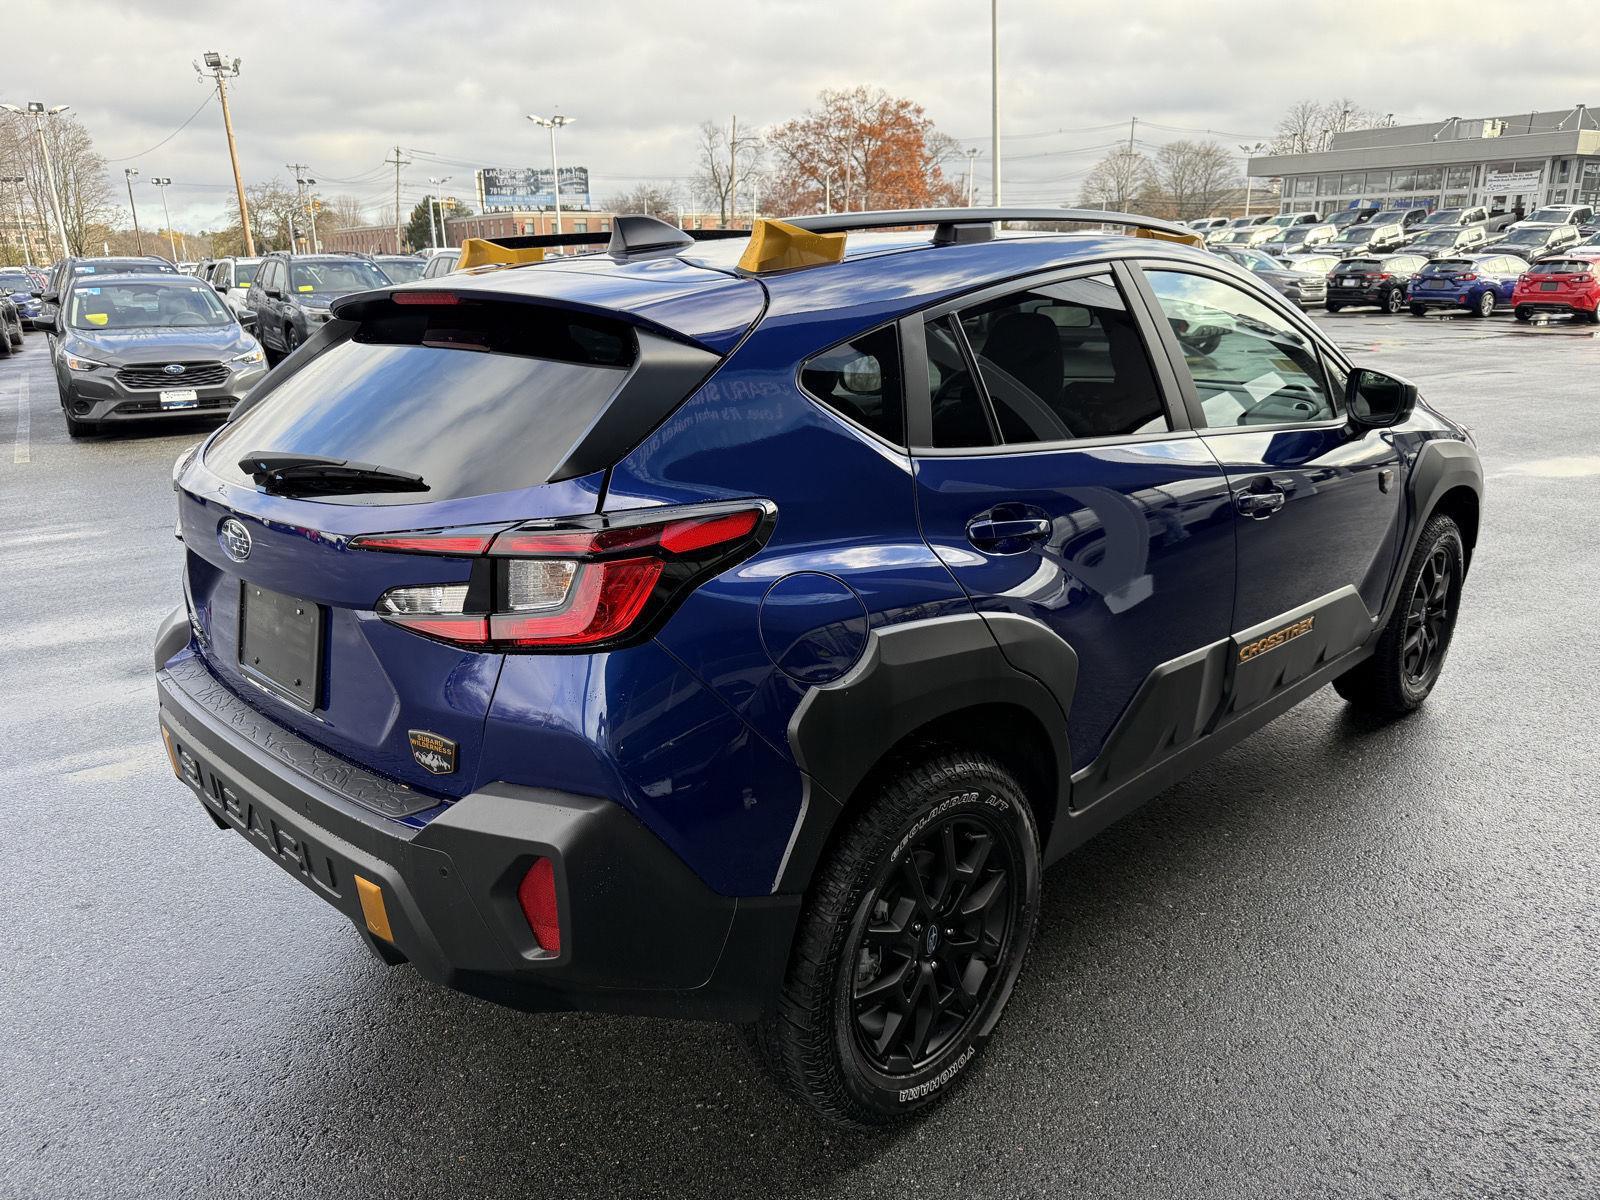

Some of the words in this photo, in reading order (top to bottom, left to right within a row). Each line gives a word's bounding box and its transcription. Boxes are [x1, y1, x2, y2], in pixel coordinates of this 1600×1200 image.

[1239, 616, 1314, 662] CROSSTREK
[410, 739, 452, 756] WILDERNESS
[417, 734, 444, 748] SUBARU
[177, 744, 342, 899] SUBARU
[891, 792, 980, 862] GEOLANDAR
[985, 794, 1009, 812] A/T
[899, 1045, 976, 1102] YOKOHAMA
